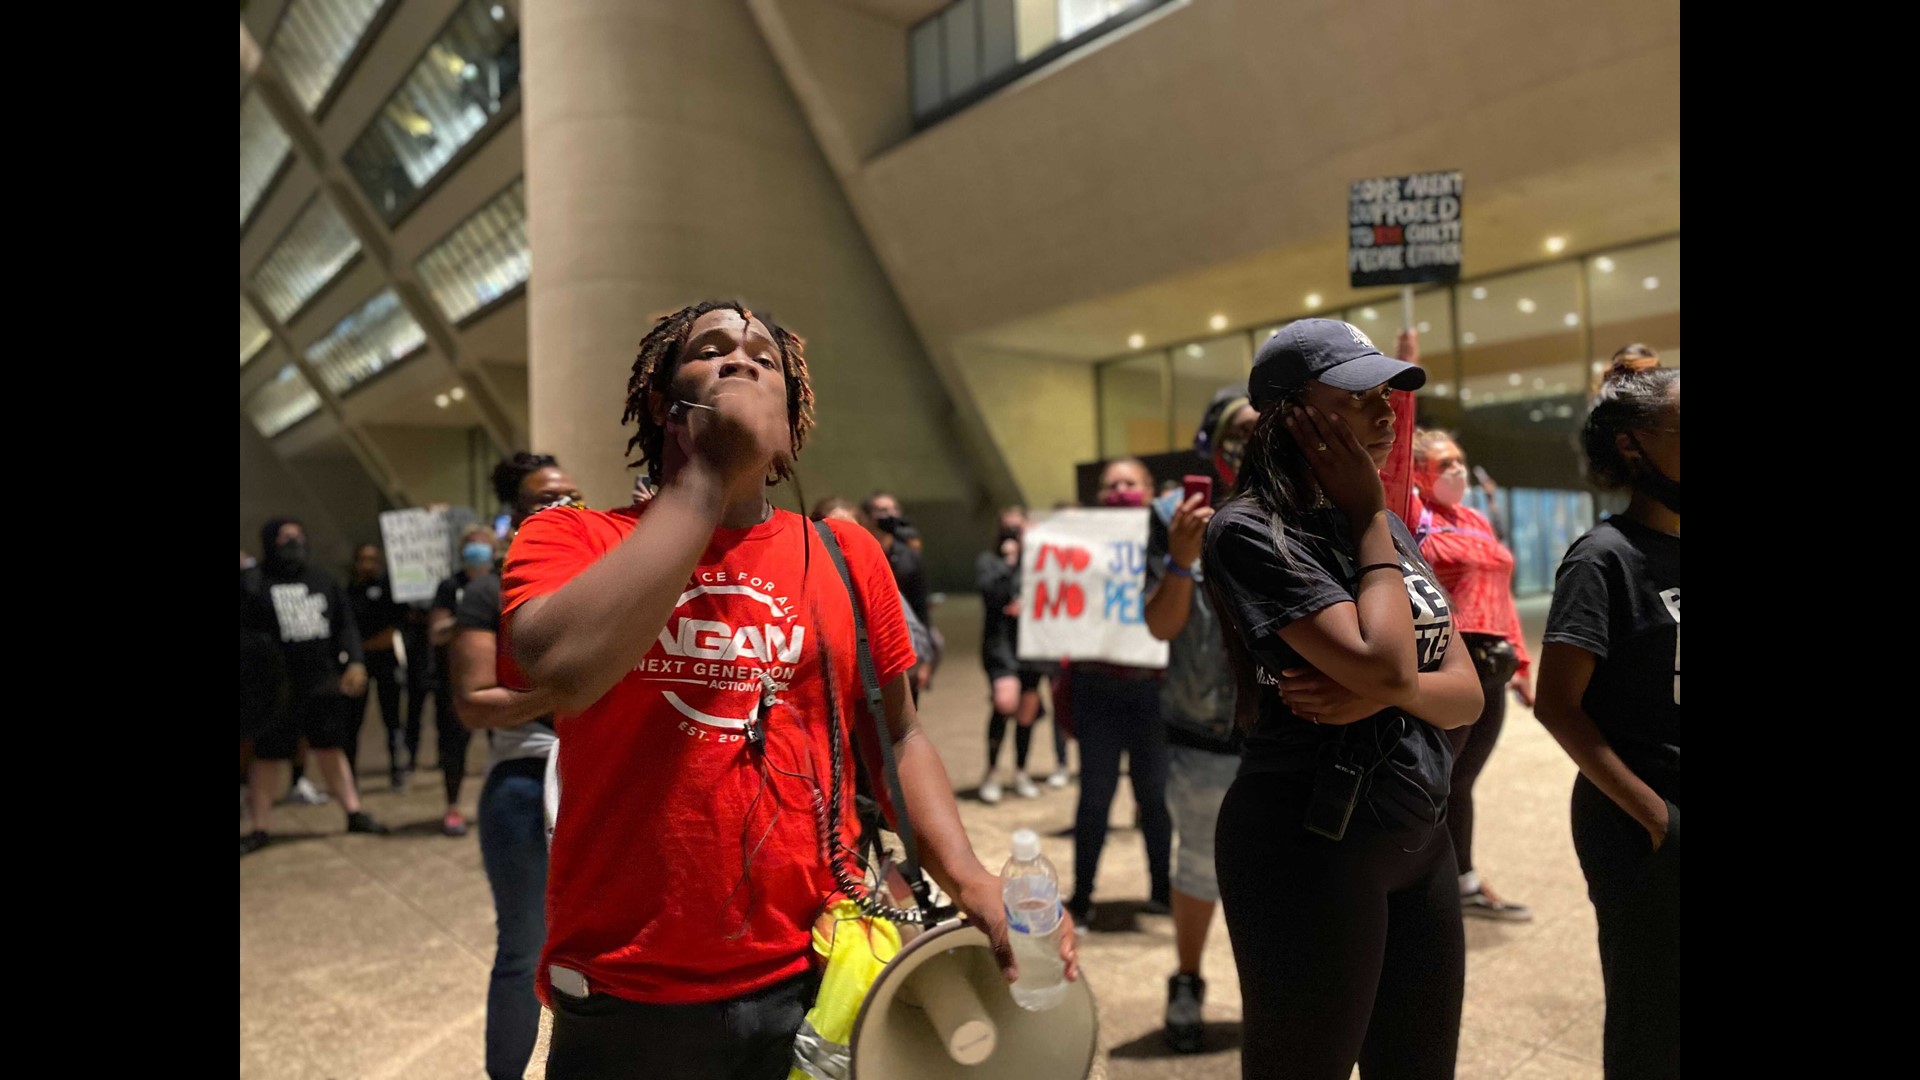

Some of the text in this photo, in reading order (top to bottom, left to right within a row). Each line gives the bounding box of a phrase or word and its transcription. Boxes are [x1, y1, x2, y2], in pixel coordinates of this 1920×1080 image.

[1033, 543, 1092, 573] NO
[737, 571, 776, 592] FOR
[774, 595, 799, 623] ALL
[1032, 578, 1145, 624] NO PE
[632, 658, 796, 680] NEXT GENERION
[677, 721, 710, 742] EST.
